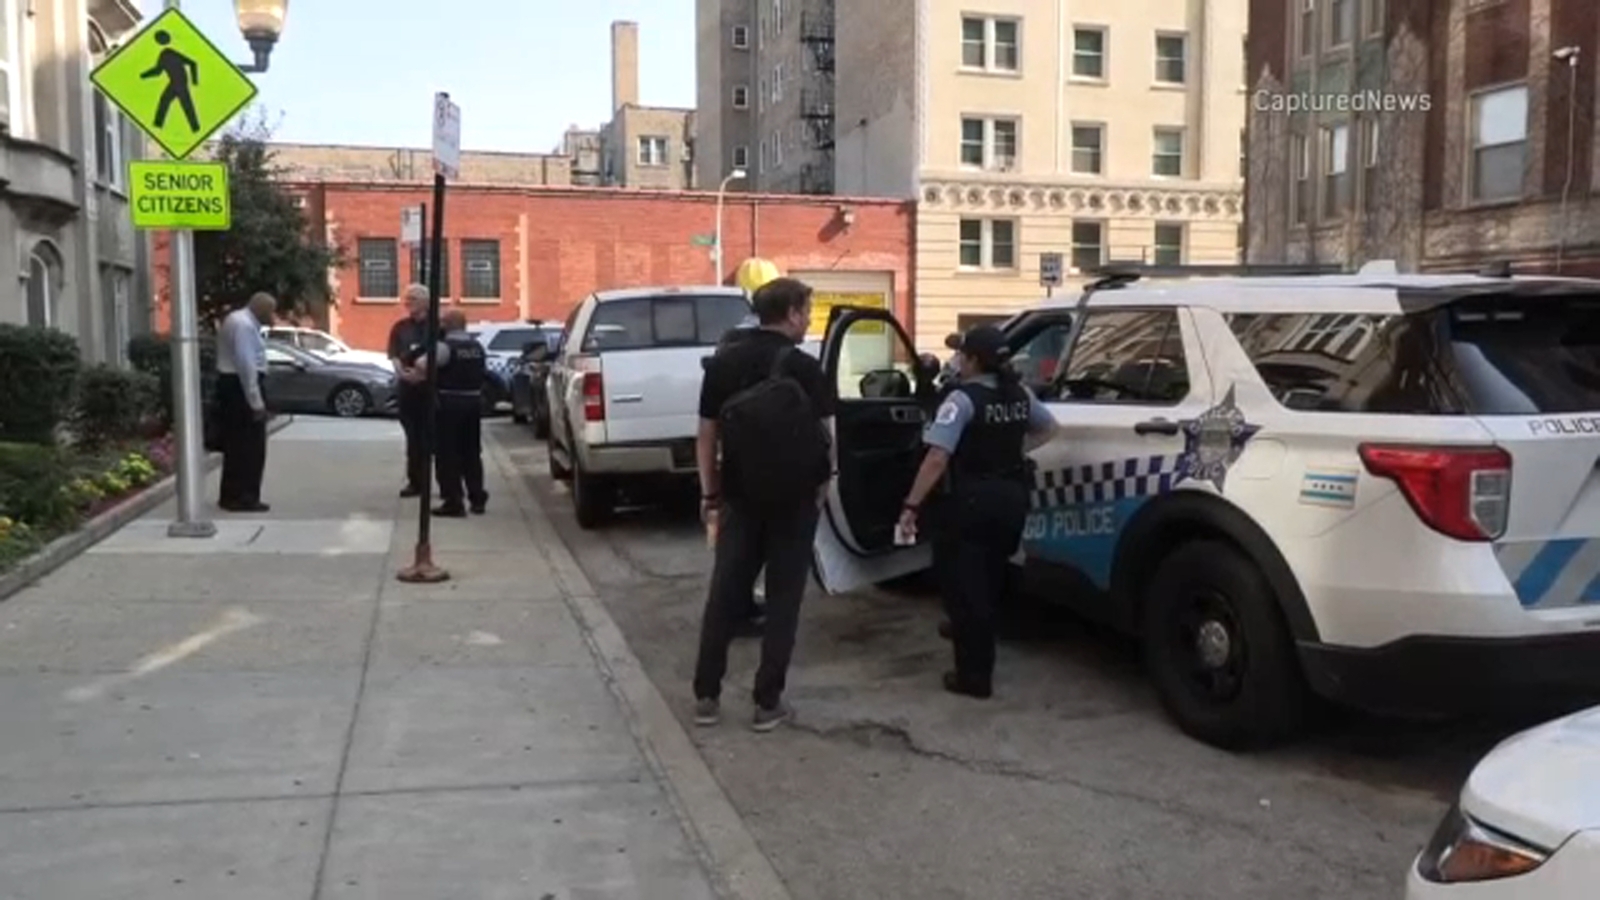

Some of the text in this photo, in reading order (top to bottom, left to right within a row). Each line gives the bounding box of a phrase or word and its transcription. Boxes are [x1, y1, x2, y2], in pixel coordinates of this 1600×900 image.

[144, 172, 213, 191] SENIOR
[137, 195, 223, 213] CITIZENS
[985, 401, 1028, 422] POLICE
[1051, 505, 1115, 540] POLICE
